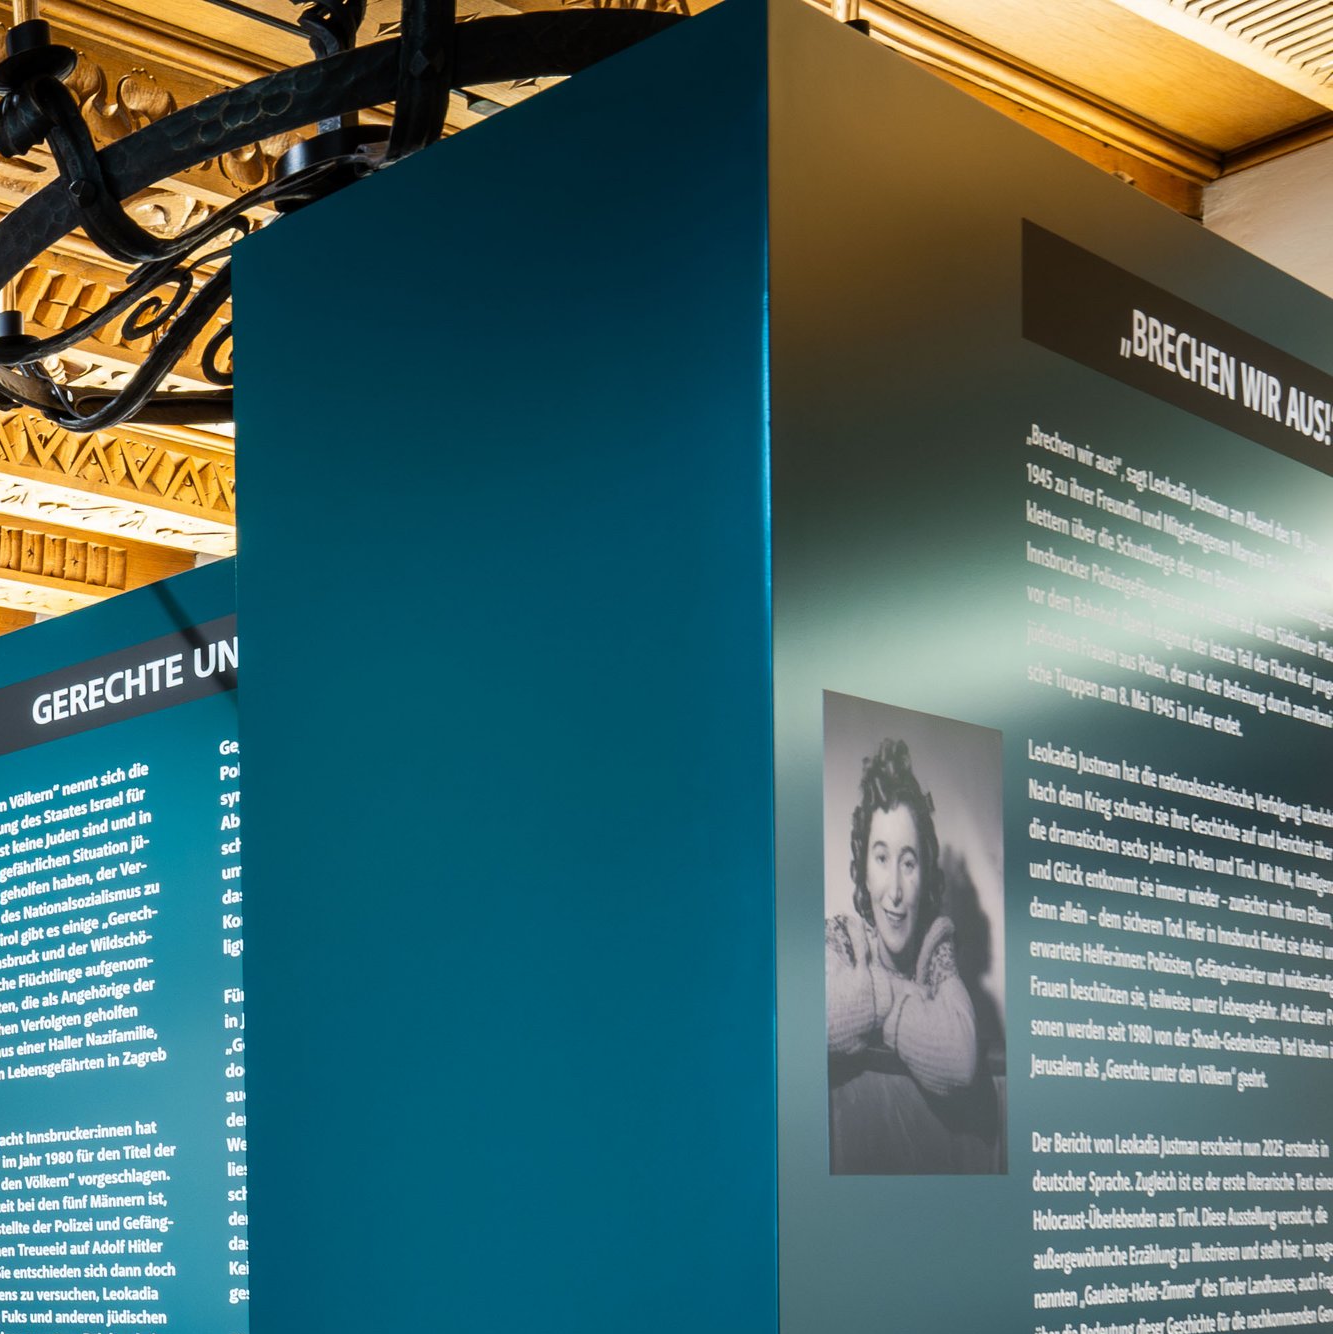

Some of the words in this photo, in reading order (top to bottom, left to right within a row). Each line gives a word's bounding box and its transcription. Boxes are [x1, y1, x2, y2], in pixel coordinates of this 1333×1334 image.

[1119, 308, 1235, 401] „BRECHEN
[1240, 362, 1281, 422] WIR
[32, 653, 183, 725] GERECHTE
[8, 783, 59, 810] Völkern“
[61, 775, 99, 796] nennt
[100, 767, 126, 787] sich
[128, 762, 149, 779] die
[20, 814, 42, 830] des
[43, 803, 88, 824] Staates
[89, 790, 124, 813] Israel
[125, 787, 146, 804] für
[1028, 778, 1057, 804] Nach
[1058, 784, 1083, 809] dem
[1084, 790, 1112, 821] Krieg
[1113, 797, 1154, 824] schreibt
[1155, 805, 1169, 827] sie
[1170, 807, 1190, 831] ihre
[1191, 813, 1240, 842] Geschichte
[1241, 825, 1257, 845] auf
[1257, 829, 1275, 849] und
[25, 1124, 133, 1145] Innsbrucker:innen
[135, 1120, 157, 1135] hat
[1032, 1131, 1052, 1153] Der
[1054, 1131, 1092, 1154] Bericht
[1093, 1138, 1114, 1154] von
[1115, 1133, 1160, 1155] Leokadia
[1160, 1135, 1199, 1159] Justman
[1200, 1135, 1242, 1156] erscheint
[1262, 1138, 1284, 1157] 2025
[1284, 1138, 1320, 1158] erstmals
[1320, 1139, 1330, 1158] in
[1033, 1207, 1157, 1231] Holocaust-Überlebenden
[1158, 1212, 1176, 1228] aus
[1176, 1206, 1201, 1227] Tirol.
[1201, 1206, 1227, 1227] Diese
[1227, 1205, 1277, 1231] Ausstellung
[1314, 1205, 1329, 1225] die
